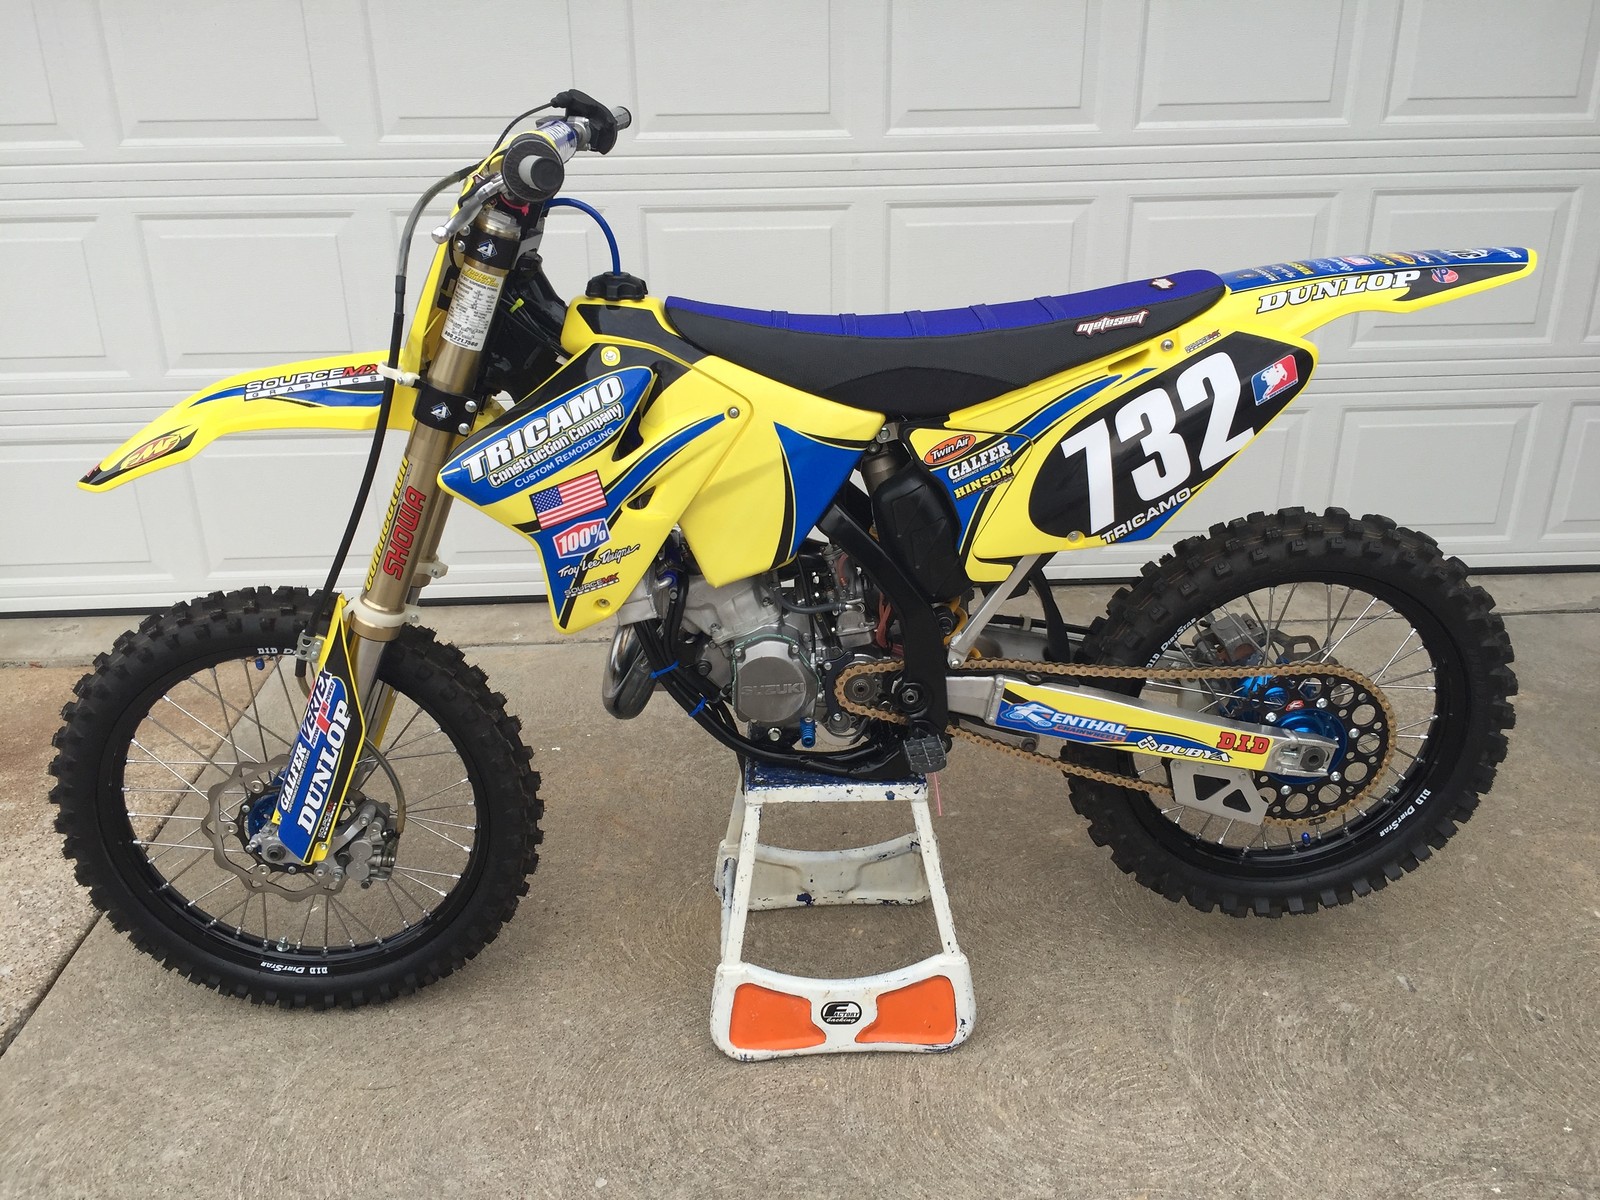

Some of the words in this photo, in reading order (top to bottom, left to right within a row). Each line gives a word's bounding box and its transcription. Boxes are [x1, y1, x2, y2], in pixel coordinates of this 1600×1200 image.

[1256, 270, 1420, 314] DUNLOP
[1077, 311, 1149, 333] motoseat
[245, 363, 378, 393] SOURCEMX
[252, 376, 377, 398] GRAPHICS
[462, 375, 624, 482] TRICAMO
[488, 435, 570, 487] Construction
[570, 402, 624, 443] Company
[1061, 352, 1255, 535] 732
[930, 444, 956, 461] Twin
[955, 436, 970, 450] Air
[948, 442, 1012, 480] GALFER
[953, 465, 1013, 499] HINSON
[383, 485, 427, 580] SHOWA
[1101, 488, 1191, 544] TRICAMO
[558, 522, 607, 555] 100%
[558, 565, 582, 579] Troy
[581, 556, 600, 570] Lee
[600, 544, 640, 565] Designs
[257, 647, 278, 655] DID
[301, 670, 332, 741] VERTEX
[1057, 725, 1125, 741] CHAINWHEELS
[297, 699, 352, 835] DUNLOP
[1157, 743, 1232, 762] DUBYA
[280, 741, 306, 812] GALFER
[1415, 789, 1431, 805] DID
[309, 967, 328, 975] DID
[824, 1003, 860, 1018] FACTORY
